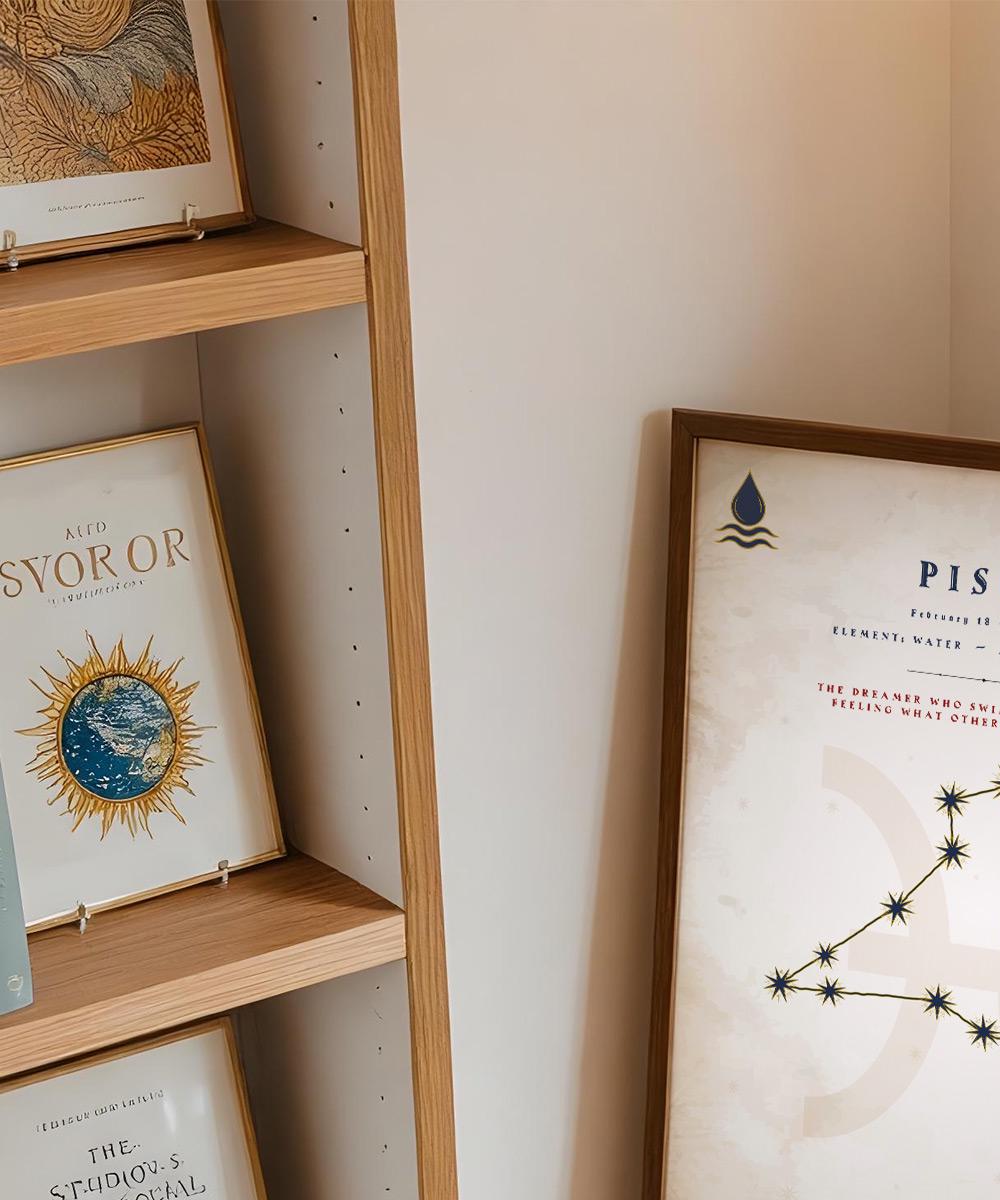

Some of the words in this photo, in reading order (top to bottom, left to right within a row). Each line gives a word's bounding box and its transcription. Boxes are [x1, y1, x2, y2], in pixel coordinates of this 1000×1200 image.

[910, 608, 969, 626] February
[912, 635, 961, 650] WATER
[817, 682, 844, 695] THE
[852, 687, 921, 705] DREAMER
[929, 697, 962, 710] WHO
[831, 697, 892, 715] FEELING
[901, 707, 943, 722] WHAT
